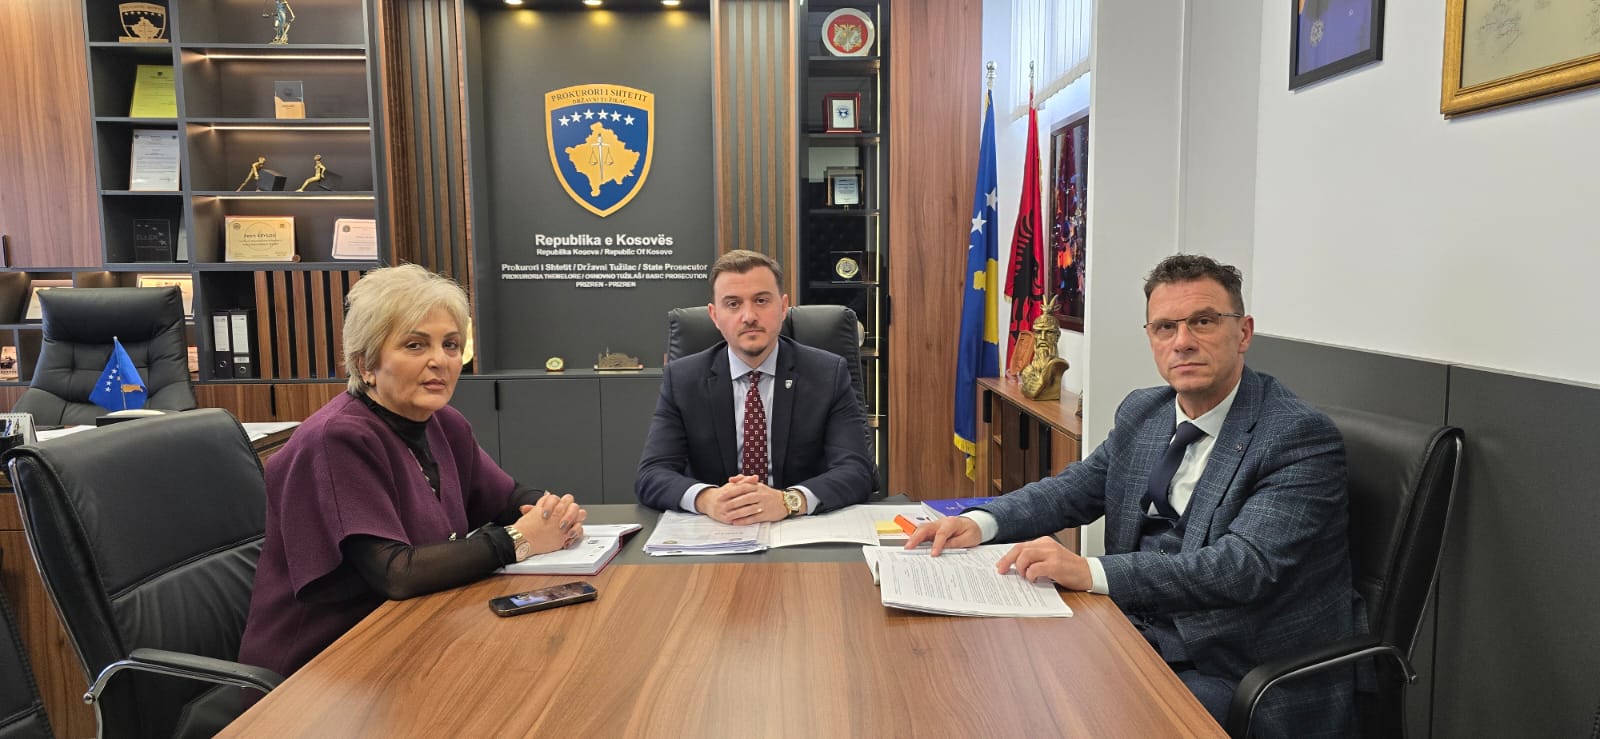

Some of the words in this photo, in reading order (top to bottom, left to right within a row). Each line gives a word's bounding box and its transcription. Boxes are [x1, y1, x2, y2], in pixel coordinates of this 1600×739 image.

[551, 88, 603, 102] PROKURORI
[610, 89, 648, 102] SHTETIT
[535, 234, 602, 248] Republika
[604, 236, 613, 246] e
[616, 233, 674, 246] Kosovës
[537, 248, 572, 256] Republika
[604, 248, 636, 256] Republic
[501, 263, 539, 271] Prokurori
[545, 263, 572, 271] Shtetit
[577, 262, 608, 271] Državni
[609, 262, 637, 271] Tužilac
[642, 263, 663, 271] State
[664, 263, 708, 271] Prosecutor
